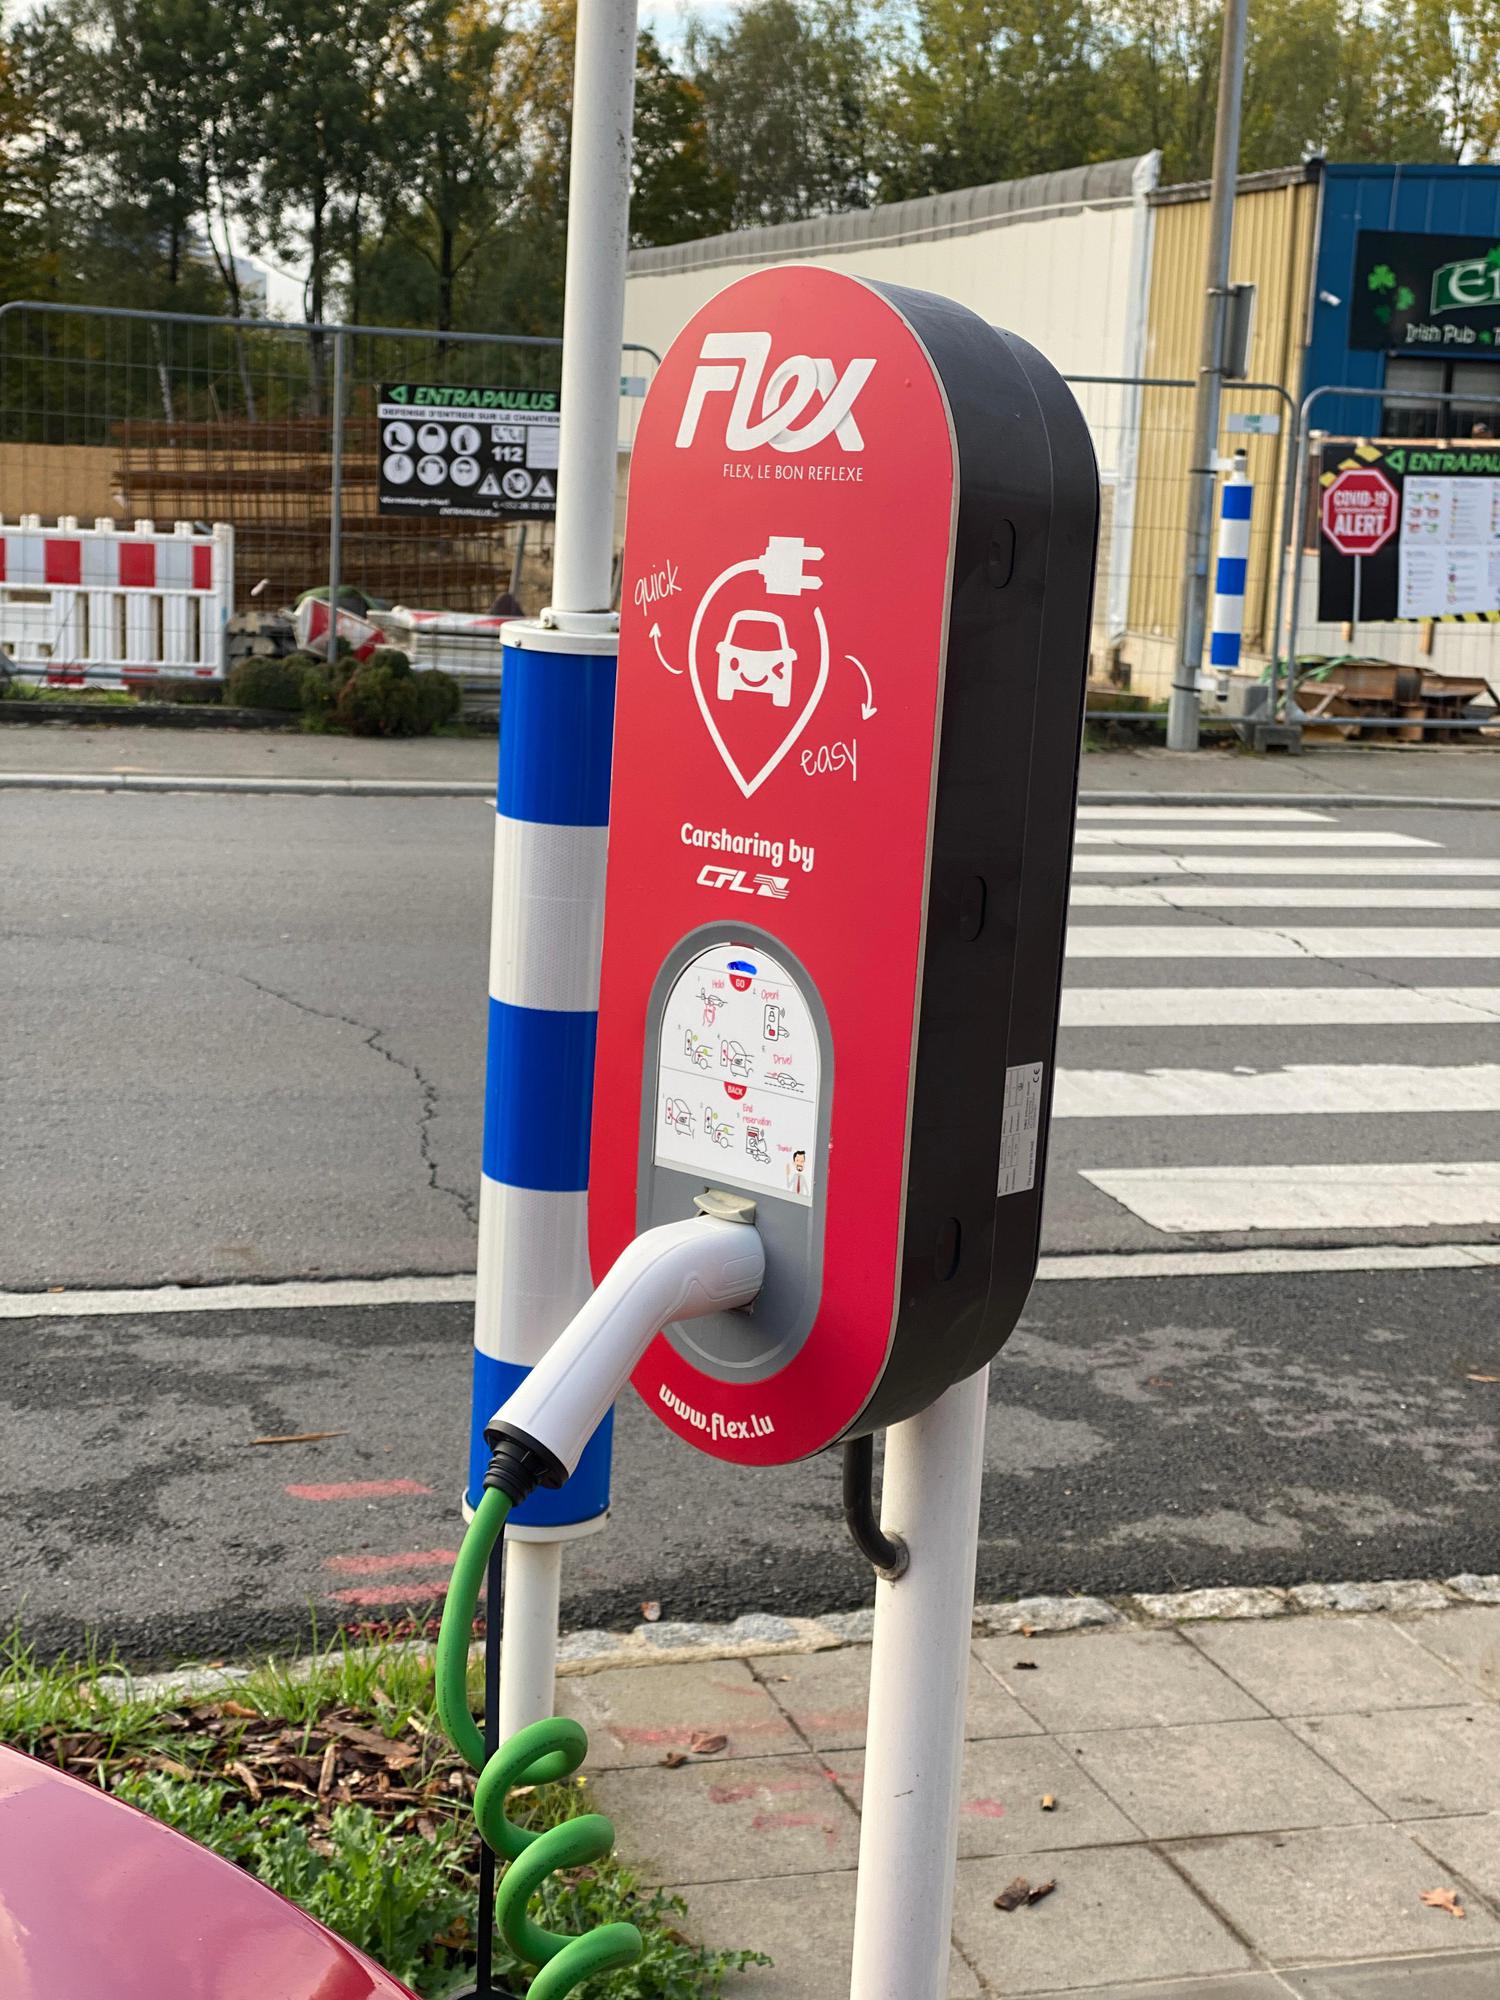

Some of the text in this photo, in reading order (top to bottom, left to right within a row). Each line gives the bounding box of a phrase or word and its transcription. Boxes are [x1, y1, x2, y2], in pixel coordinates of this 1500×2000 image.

[1405, 322, 1441, 343] Irish
[1442, 323, 1477, 344] Pub
[413, 386, 557, 411] ENTRAPAULUS
[477, 412, 497, 420] SUR
[500, 413, 510, 421] LE
[491, 446, 524, 463] 112
[722, 463, 864, 482] FLEX, LE BON REFLEXE
[1333, 490, 1389, 507] COVID-19
[1334, 513, 1387, 536] ALERT
[634, 559, 682, 616] quick
[799, 738, 857, 781] easy
[680, 822, 815, 873] Carsharing by
[696, 864, 755, 894] CFL
[735, 978, 746, 988] GO
[727, 1084, 744, 1096] BACK
[658, 1383, 776, 1441] www.flex.lu
